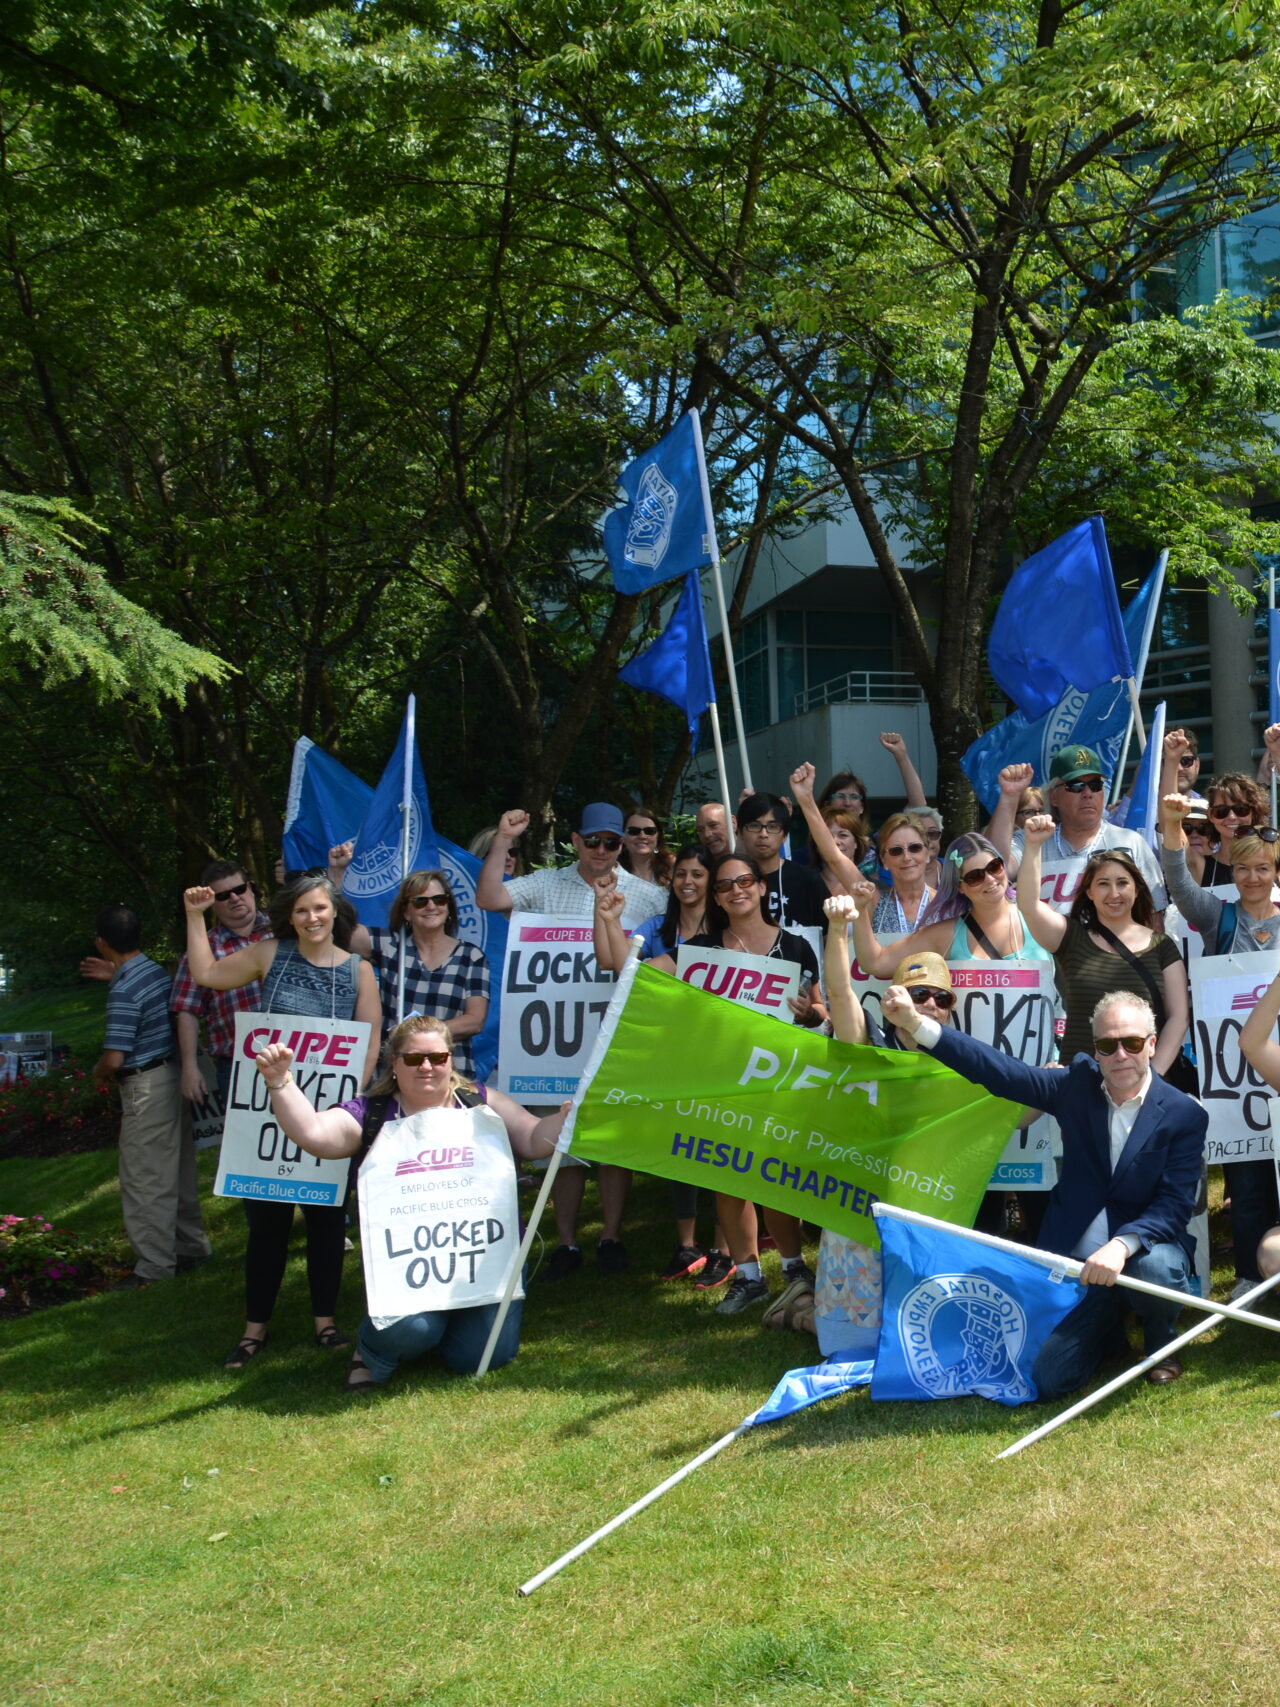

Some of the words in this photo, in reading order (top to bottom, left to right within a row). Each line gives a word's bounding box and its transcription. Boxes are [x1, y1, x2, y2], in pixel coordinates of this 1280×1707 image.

[544, 930, 576, 941] CUPE
[579, 930, 593, 941] 18
[506, 950, 620, 994] LOCK
[682, 962, 791, 1008] CUPE
[950, 973, 973, 986] UPE
[977, 973, 1010, 986] 1816
[738, 991, 755, 1002] 1816
[242, 1028, 359, 1067] CUPE
[951, 991, 1055, 1067] CKED
[230, 1060, 359, 1115] LOKED
[514, 1079, 551, 1092] Pacific
[554, 1080, 578, 1093] Blue
[257, 1122, 322, 1167] OU
[416, 1146, 474, 1166] CUPE
[671, 1133, 754, 1173] HESU
[676, 1099, 753, 1131] Union
[763, 1116, 800, 1144] for
[807, 1131, 957, 1201] Professionals
[230, 1179, 266, 1195] Pacific
[267, 1183, 295, 1198] Blue
[297, 1186, 330, 1201] Cross
[401, 1179, 459, 1195] EMPLOYEES
[460, 1177, 474, 1188] OF
[998, 1165, 1036, 1178] Cross
[390, 1203, 428, 1216] PACIFIC
[429, 1200, 454, 1211] BLUE
[457, 1197, 489, 1208] CROSS
[384, 1218, 505, 1259] LOCKED
[405, 1248, 486, 1290] OUT
